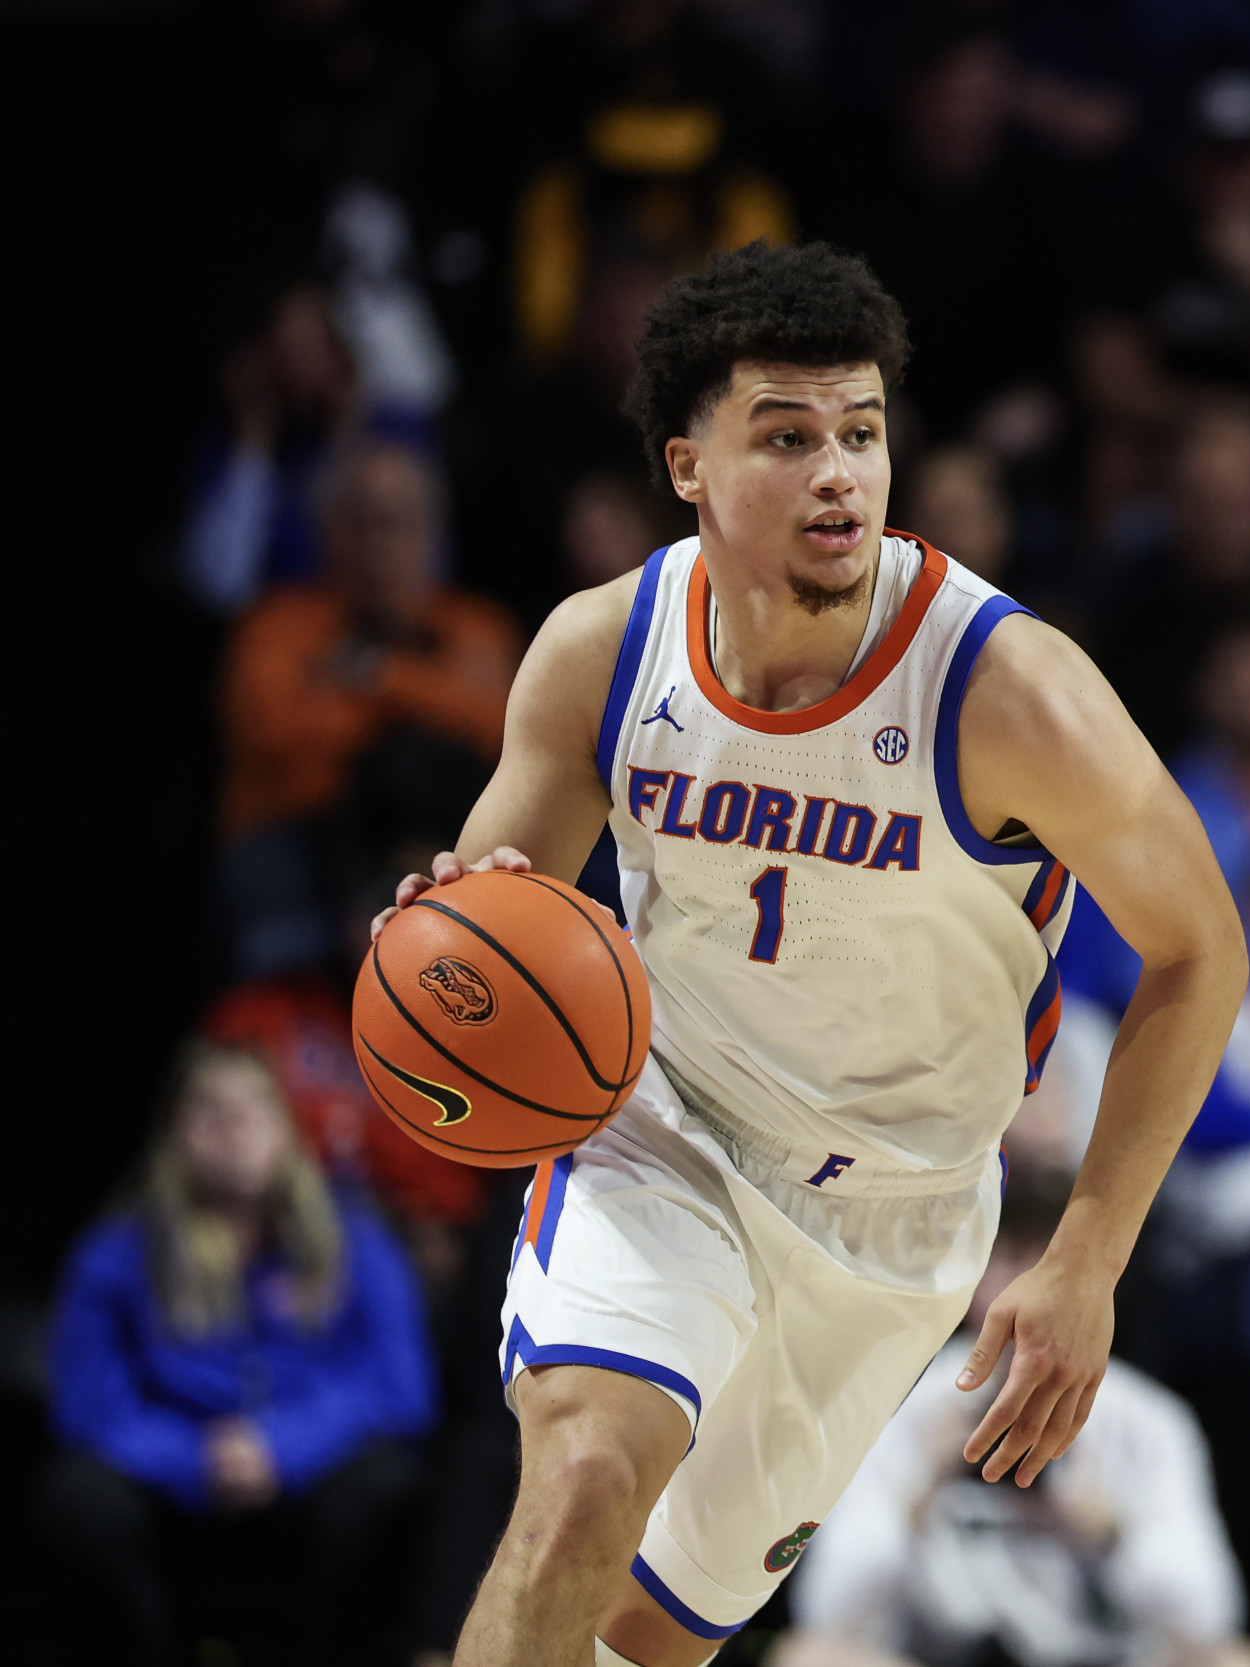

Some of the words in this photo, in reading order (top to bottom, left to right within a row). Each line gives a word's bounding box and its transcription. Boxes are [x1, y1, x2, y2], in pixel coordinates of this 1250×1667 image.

[876, 728, 906, 762] SEC
[627, 765, 922, 871] FLORIDA
[748, 867, 788, 964] 1
[803, 1152, 856, 1188] F
